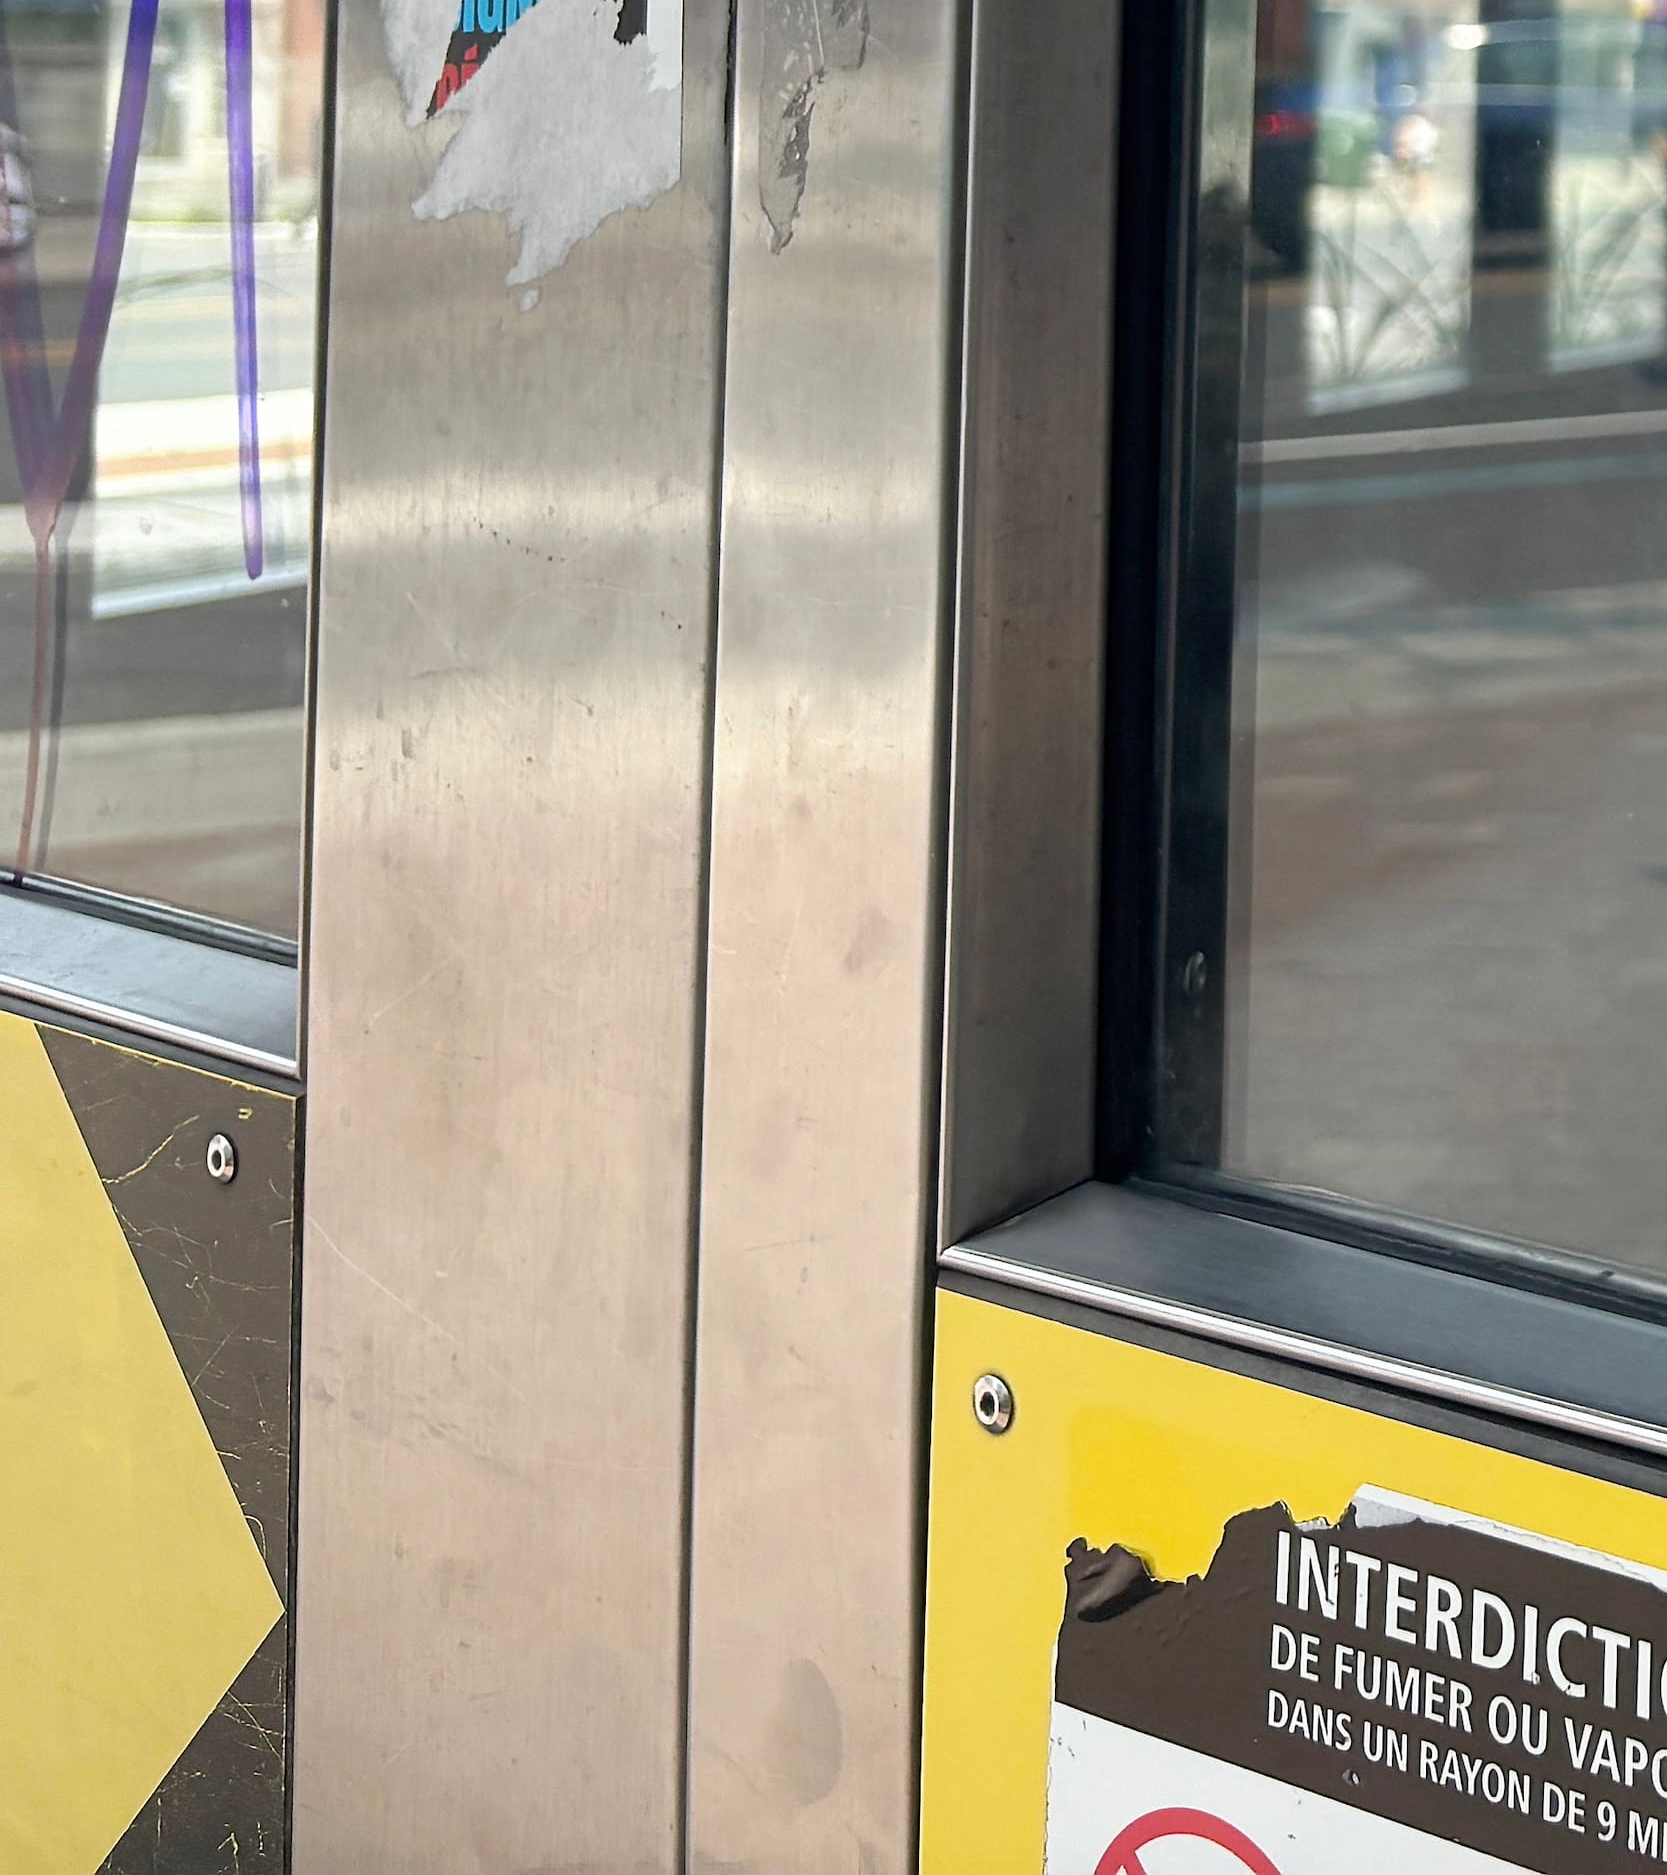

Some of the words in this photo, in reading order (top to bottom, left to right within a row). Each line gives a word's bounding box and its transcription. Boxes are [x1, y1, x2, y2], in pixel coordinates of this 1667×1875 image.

[1270, 1623, 1321, 1683] DE
[1333, 1643, 1474, 1733] FUMER
[1488, 1693, 1549, 1757] OU
[1267, 1689, 1353, 1752] DANS
[1362, 1721, 1409, 1772] UN
[1419, 1739, 1532, 1816] RAYON
[1543, 1780, 1587, 1833] DE
[1597, 1800, 1617, 1843] 9
